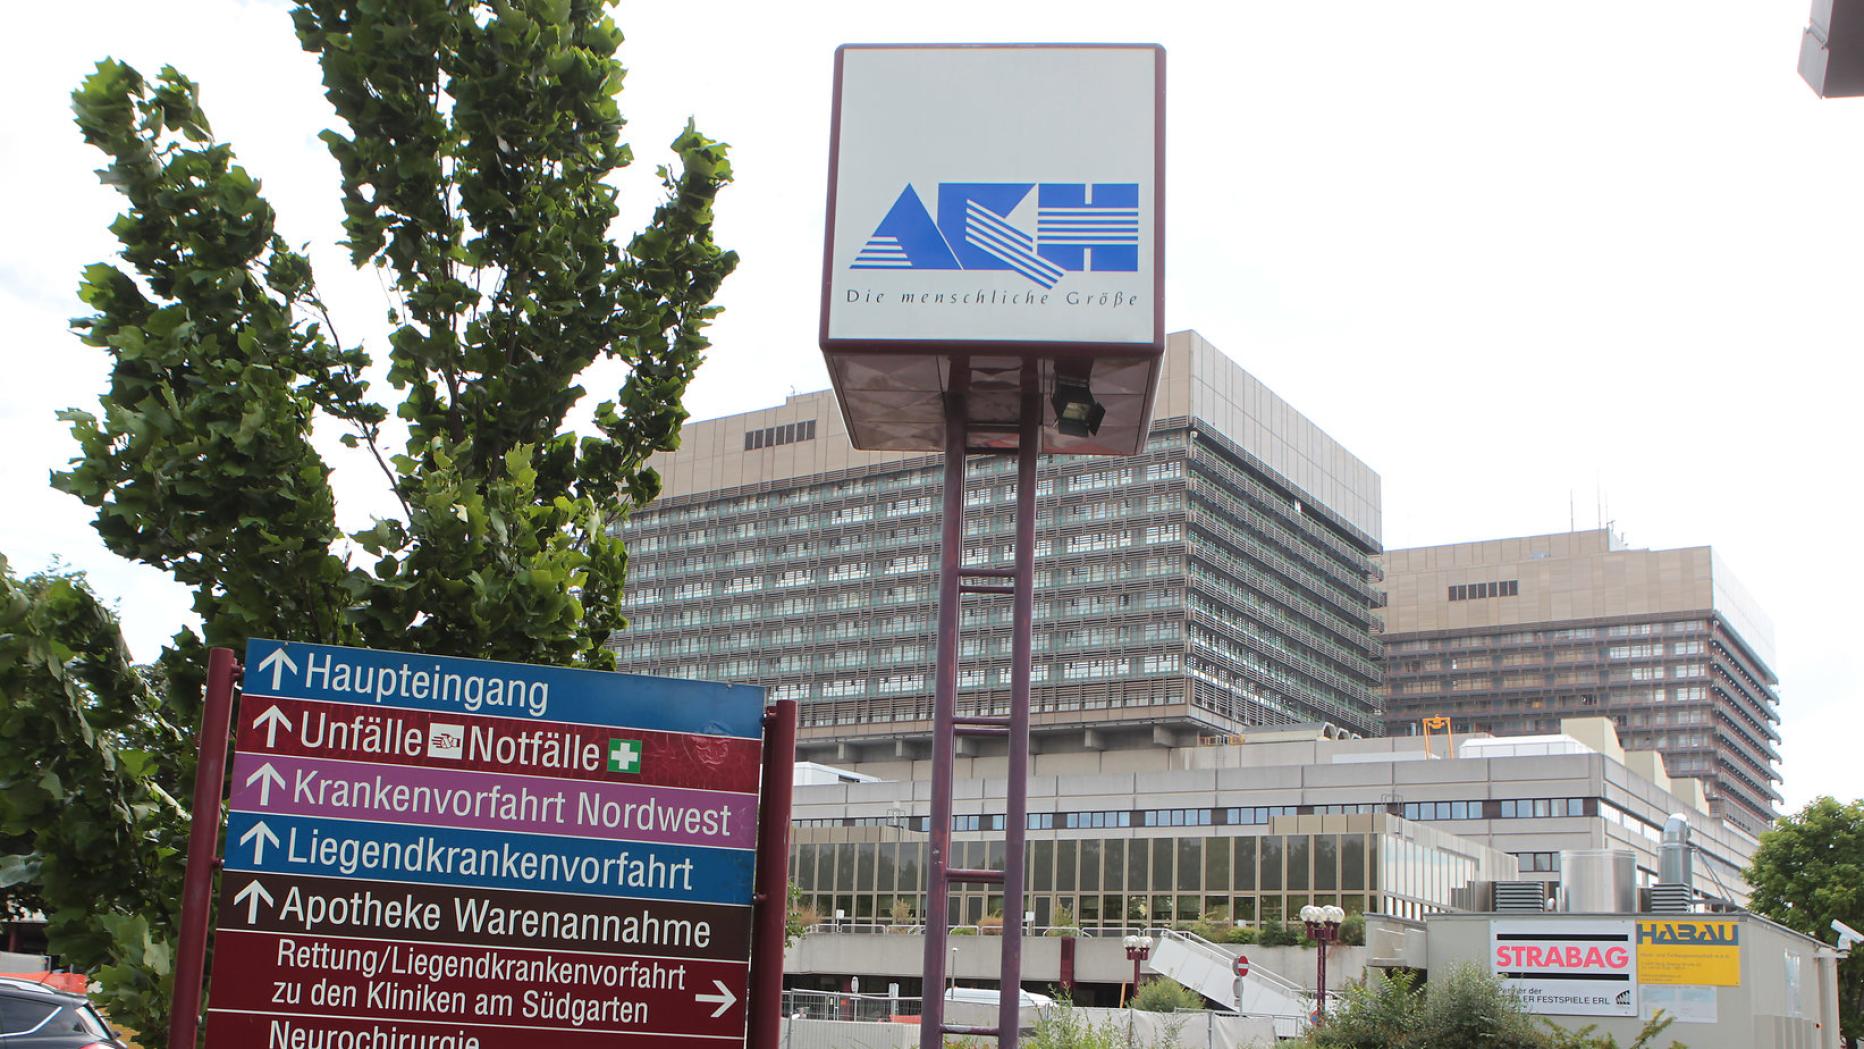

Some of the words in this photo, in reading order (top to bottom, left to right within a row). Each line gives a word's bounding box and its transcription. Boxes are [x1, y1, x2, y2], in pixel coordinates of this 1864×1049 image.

[849, 182, 1139, 290] AKH
[847, 289, 884, 304] Die
[901, 289, 1049, 306] menschliche
[1066, 290, 1138, 309] Größe
[305, 652, 549, 717] Haupteingang
[300, 710, 423, 757] Unfälle
[469, 725, 600, 771] Notfälle
[293, 769, 566, 824] Krankenvorfahrt
[577, 792, 732, 837] Nordwest
[287, 827, 694, 891] Liegendkrankenvorfahrt
[279, 886, 441, 931] Apotheke
[454, 897, 711, 948] Warenannahme
[1636, 923, 1739, 946] HABAU
[277, 938, 686, 991] Rettung/Liegendkrankenvorfahrt
[1495, 945, 1630, 970] STRABAG
[271, 981, 301, 1004] zu
[310, 978, 357, 1008] den
[367, 980, 466, 1014] Kliniken
[474, 993, 513, 1017] am
[522, 988, 648, 1025] Südgarten
[1528, 987, 1542, 995] der
[1536, 995, 1591, 1005] FESTSPIELE
[1592, 996, 1611, 1006] ERL
